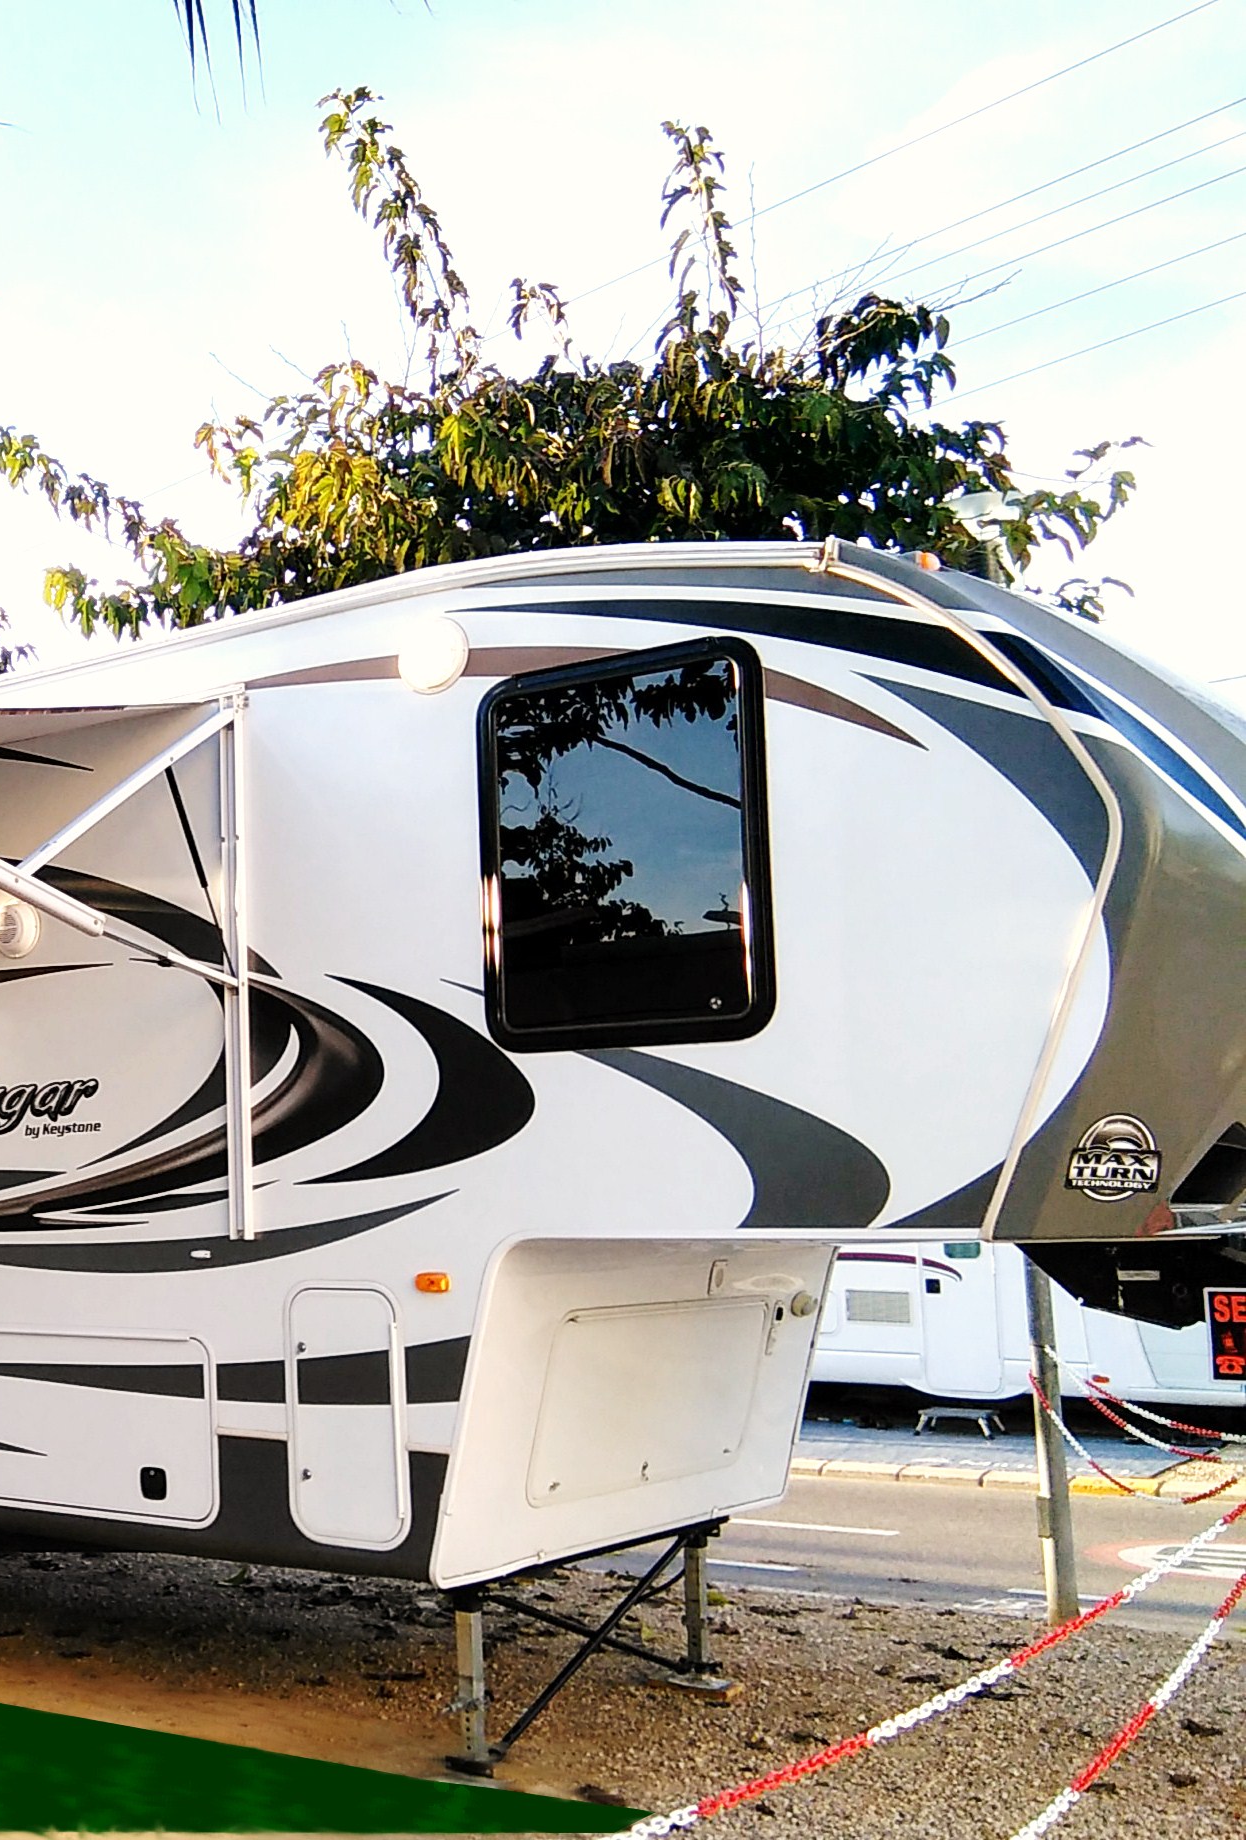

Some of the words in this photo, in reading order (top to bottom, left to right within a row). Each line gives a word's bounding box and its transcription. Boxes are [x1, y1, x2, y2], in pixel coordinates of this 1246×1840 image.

[25, 1125, 40, 1138] by
[42, 1122, 102, 1137] Keystone
[1076, 1153, 1151, 1167] MAX
[1073, 1166, 1154, 1180] TURN
[1071, 1180, 1152, 1190] TECHNOLOGY
